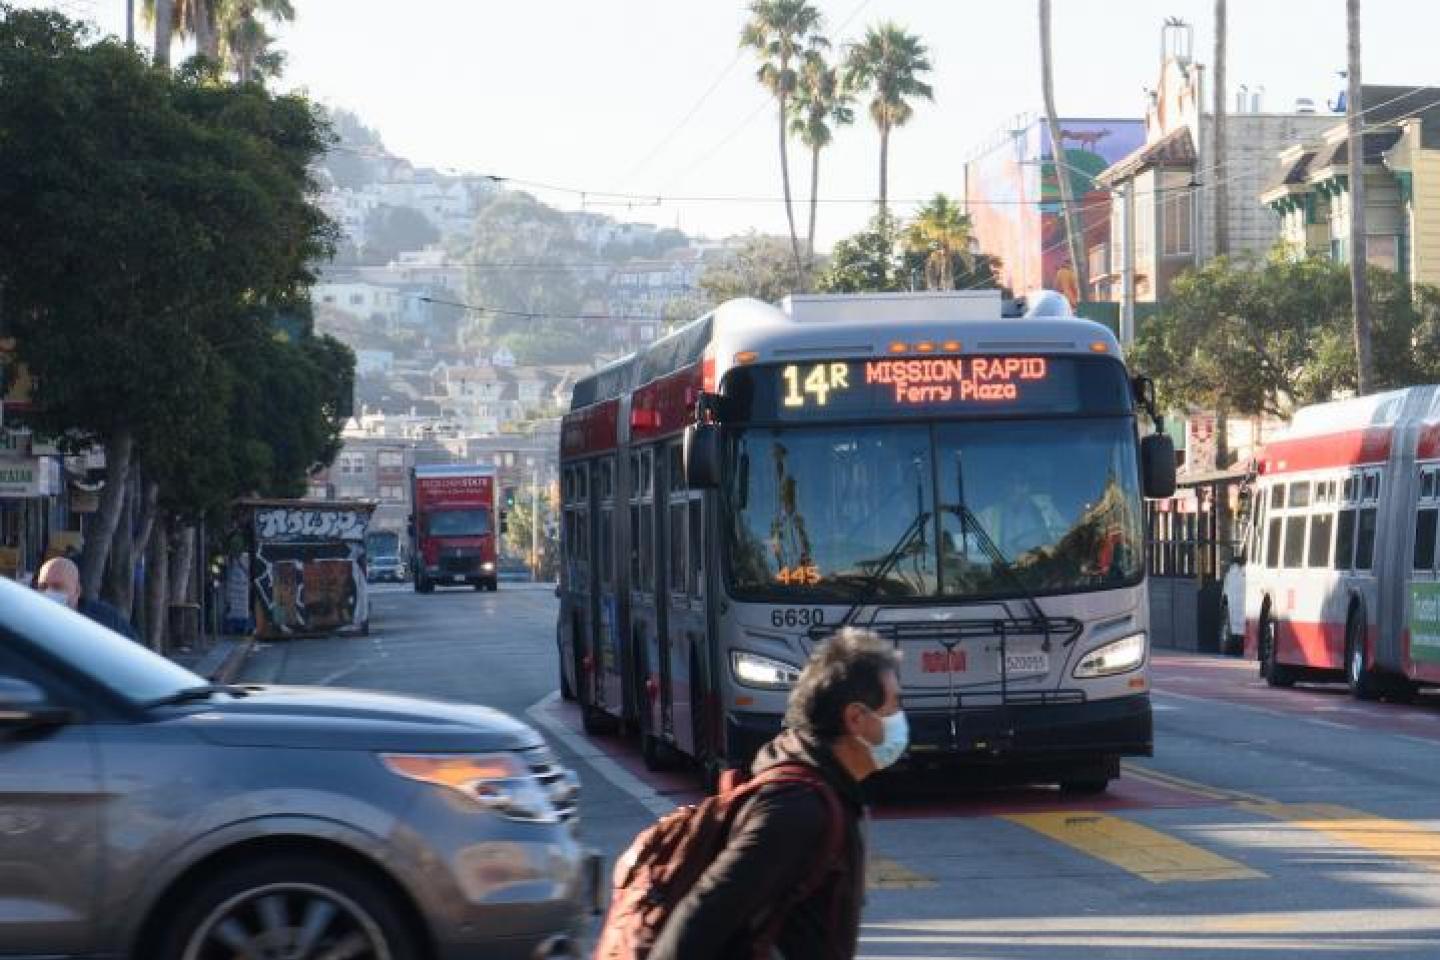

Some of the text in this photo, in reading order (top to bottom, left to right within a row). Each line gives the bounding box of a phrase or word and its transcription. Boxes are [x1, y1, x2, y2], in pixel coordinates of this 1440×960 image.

[866, 357, 1046, 384] MISSION RAPID
[896, 379, 1017, 403] Ferry Plaza
[775, 566, 822, 585] 445
[771, 607, 824, 627] 6630
